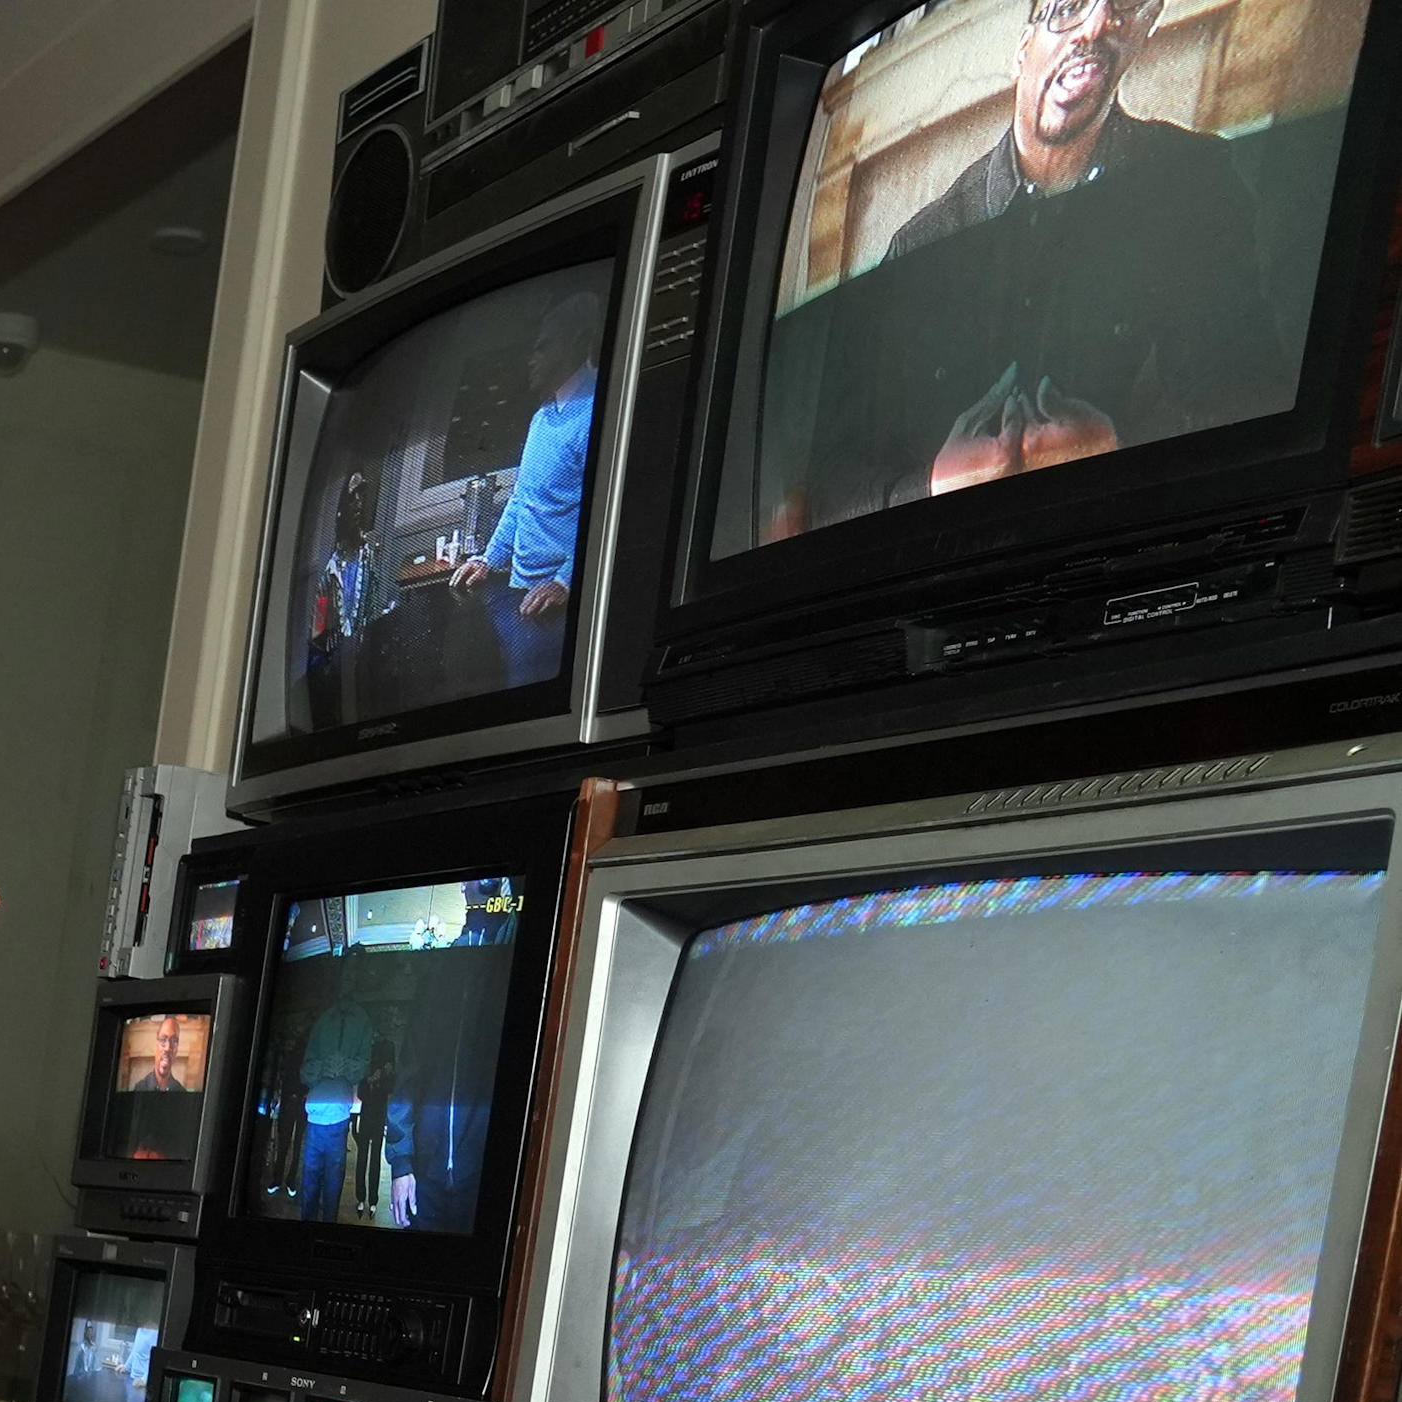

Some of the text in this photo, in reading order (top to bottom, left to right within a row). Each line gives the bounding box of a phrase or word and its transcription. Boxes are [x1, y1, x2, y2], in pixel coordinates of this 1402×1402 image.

[1123, 615, 1145, 624] DIGITAL
[1147, 610, 1173, 619] CONTROL
[1328, 692, 1402, 714] COLORTRAK
[290, 1376, 316, 1390] SONY
